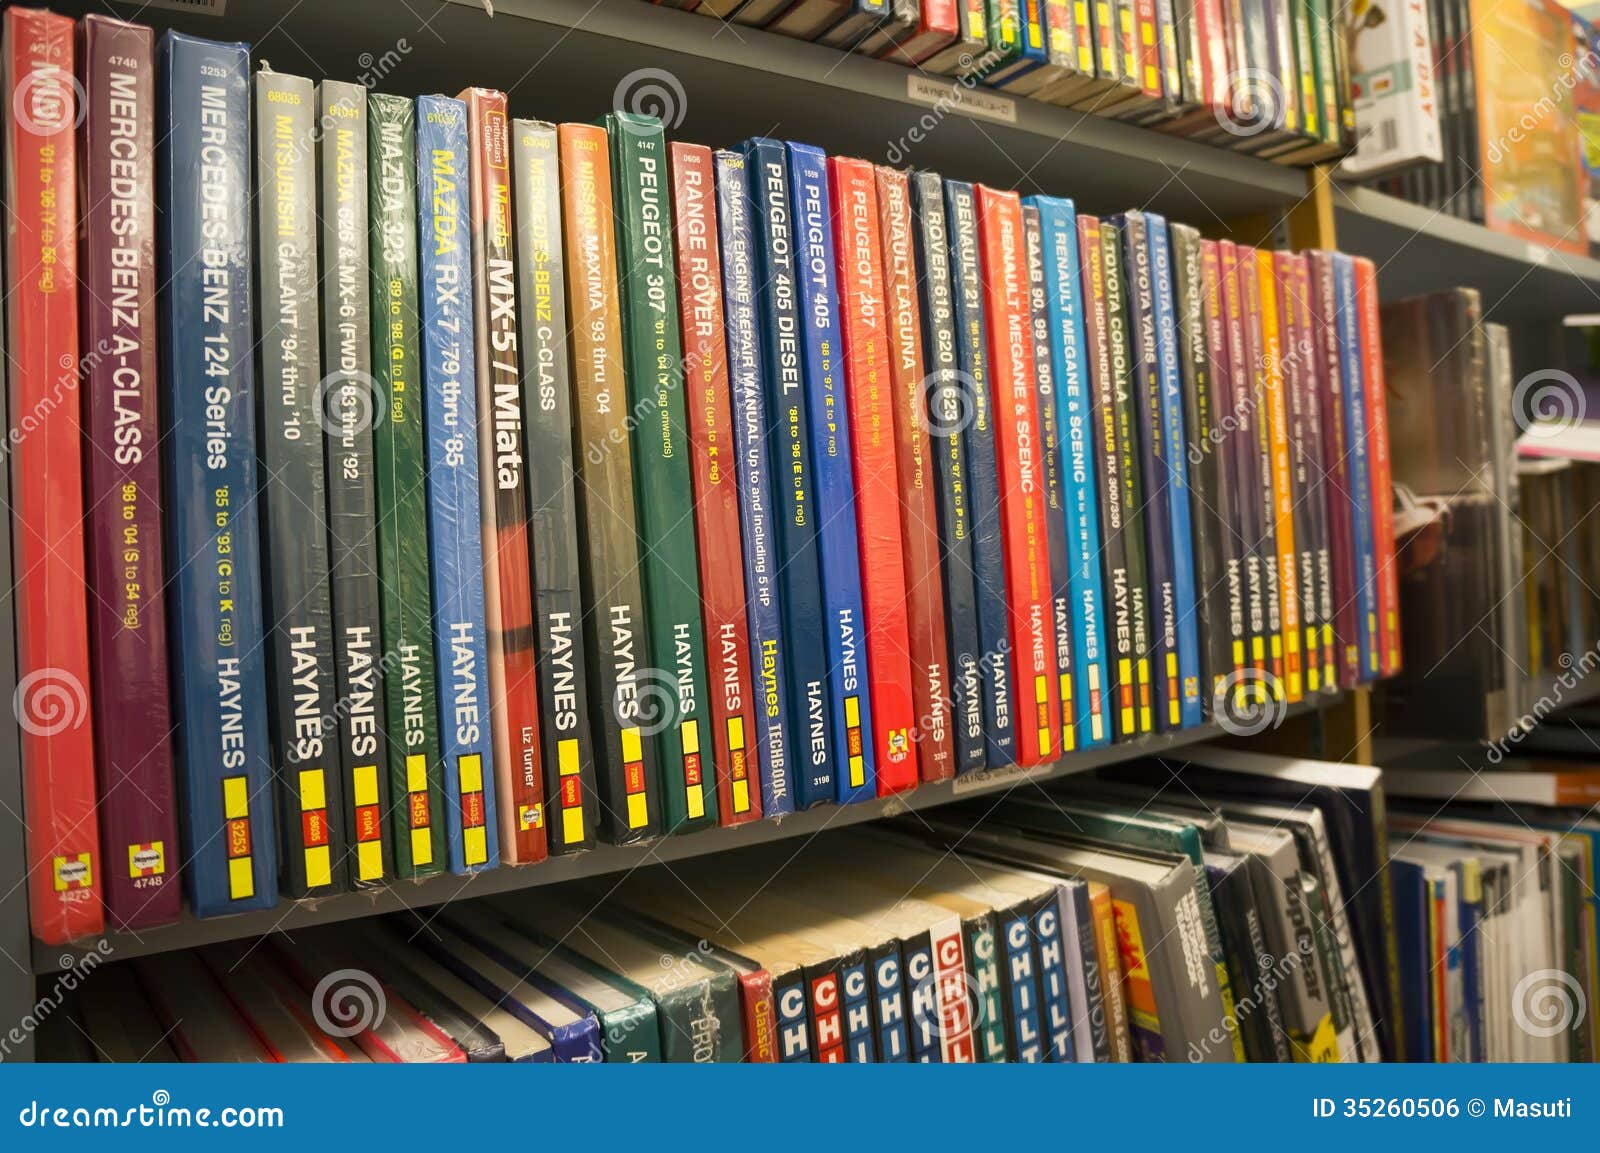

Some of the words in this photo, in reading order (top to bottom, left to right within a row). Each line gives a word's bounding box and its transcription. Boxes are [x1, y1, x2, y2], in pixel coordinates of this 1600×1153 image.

[108, 56, 137, 69] 4748
[200, 65, 228, 78] 3253
[31, 61, 61, 128] MINI
[275, 115, 296, 236] MITSUBISHI
[336, 129, 355, 202] MAZDA
[380, 121, 405, 212] MAZDA
[109, 72, 139, 327] MERCEDES-BENZ
[200, 85, 228, 323] MERCEDES-BENZ
[431, 149, 457, 256] MAZDA
[491, 183, 508, 248] Mazda
[579, 161, 597, 229] NISSAN
[639, 157, 663, 268] PEUGEOT
[685, 170, 705, 250] RANGE
[727, 180, 743, 235] SMALL
[766, 162, 789, 267] PEUGEOT
[338, 207, 355, 241] 626
[383, 220, 405, 263] 323
[529, 158, 551, 321] MERCEDES-BENZ
[805, 184, 827, 288] PEUGEOT
[852, 190, 872, 286] PEUGEOT
[887, 184, 908, 282] RENAULT
[927, 211, 945, 280] ROVER
[956, 193, 977, 284] RENAULT
[339, 247, 354, 260] &
[584, 234, 605, 311] MAXIMA
[734, 240, 748, 303] ENGINE
[999, 220, 1019, 312] RENAULT
[1027, 231, 1043, 282] SAAB
[1055, 232, 1072, 315] RENAULT
[1090, 245, 1103, 299] TOYOTA
[1105, 243, 1121, 313] TOYOTA
[1136, 243, 1153, 310] TOYOTA
[1156, 246, 1171, 311] TOYOTA
[279, 242, 298, 328] GALANT
[339, 265, 357, 317] MX-6
[435, 264, 460, 334] RX-7
[489, 258, 517, 352] MX-5
[646, 275, 666, 313] 307
[691, 258, 713, 337] ROVER
[775, 274, 792, 310] 405
[813, 292, 830, 328] 405
[859, 292, 874, 327] 207
[934, 285, 949, 324] 618,
[965, 288, 979, 310] 21
[1031, 287, 1045, 313] 90,
[1186, 254, 1199, 318] TOYOTA
[203, 333, 230, 376] 124
[280, 334, 298, 361] '94
[339, 323, 358, 375] (FWD)
[591, 316, 605, 341] '93
[739, 308, 753, 367] REPAIR
[896, 285, 916, 370] LAGUNA
[937, 329, 953, 362] 620
[1034, 318, 1046, 340] 99
[1036, 345, 1048, 357] &
[1094, 301, 1113, 391] HIGHLANDER
[1142, 314, 1155, 364] YARIS
[1191, 322, 1204, 364] RAV4
[441, 342, 460, 375] '79
[538, 326, 552, 408] C-CLASS
[593, 347, 608, 383] thru
[777, 317, 798, 395] DIESEL
[942, 369, 955, 382] &
[1008, 314, 1027, 400] MEGANE
[1038, 364, 1051, 395] 900
[1062, 319, 1079, 397] MEGANE
[1110, 317, 1127, 402] COROLLA
[1161, 316, 1178, 396] COROLLA
[111, 334, 142, 464] A-CLASS
[281, 367, 299, 405] thru
[341, 381, 358, 406] '83
[442, 380, 460, 425] thru
[596, 388, 610, 414] '04
[743, 372, 758, 443] MANUAL
[942, 387, 958, 421] 623
[1015, 404, 1026, 415] &
[1069, 401, 1080, 412] &
[204, 386, 232, 469] Series
[283, 411, 300, 440] '10
[342, 410, 358, 447] thru
[445, 433, 464, 467] '85
[494, 383, 522, 490] Miata
[1069, 416, 1085, 483] SCENIC
[1103, 406, 1115, 452] LEXUS
[343, 453, 359, 479] '92
[748, 449, 759, 466] Up
[751, 470, 760, 483] to
[1016, 421, 1034, 493] SCENIC
[1106, 455, 1117, 476] RX
[122, 481, 136, 502] '98
[123, 505, 136, 519] to
[215, 485, 230, 507] '85
[752, 487, 763, 510] and
[1109, 477, 1120, 529] 300/330
[124, 524, 138, 544] '04
[217, 512, 229, 526] to
[217, 532, 232, 553] '93
[754, 514, 768, 573] including
[123, 549, 140, 562] (S
[125, 566, 139, 579] to
[216, 559, 232, 576] (C
[758, 576, 768, 584] 5
[126, 583, 140, 600] 54
[219, 581, 231, 594] to
[219, 599, 235, 613] K
[759, 587, 770, 606] HP
[1113, 568, 1130, 654] HAYNES
[1228, 559, 1242, 636] HAYNES
[1248, 556, 1263, 632] HAYNES
[1266, 556, 1280, 631] HAYNES
[123, 604, 141, 629] reg)
[217, 617, 236, 647] reg)
[1082, 589, 1097, 659] HAYNES
[1132, 587, 1146, 655] HAYNES
[1162, 582, 1175, 648] HAYNES
[549, 612, 577, 731] HAYNES
[674, 623, 695, 714] HAYNES
[720, 623, 741, 711] HAYNES
[839, 609, 857, 691] HAYNES
[290, 626, 323, 759] HAYNES
[400, 645, 425, 746] HAYNES
[450, 622, 480, 745] HAYNES
[760, 640, 780, 717] Haynes
[927, 663, 945, 742] HAYNES
[217, 658, 245, 769] HAYNES
[521, 726, 533, 744] Liz
[807, 681, 826, 766] HAYNES
[522, 746, 535, 787] Turner
[768, 723, 787, 800] TECHBOOK
[850, 730, 860, 754] 1559
[413, 795, 426, 824] 3455
[231, 821, 248, 854] 3253
[133, 876, 164, 888] 4748
[753, 1000, 769, 1060] Classic
